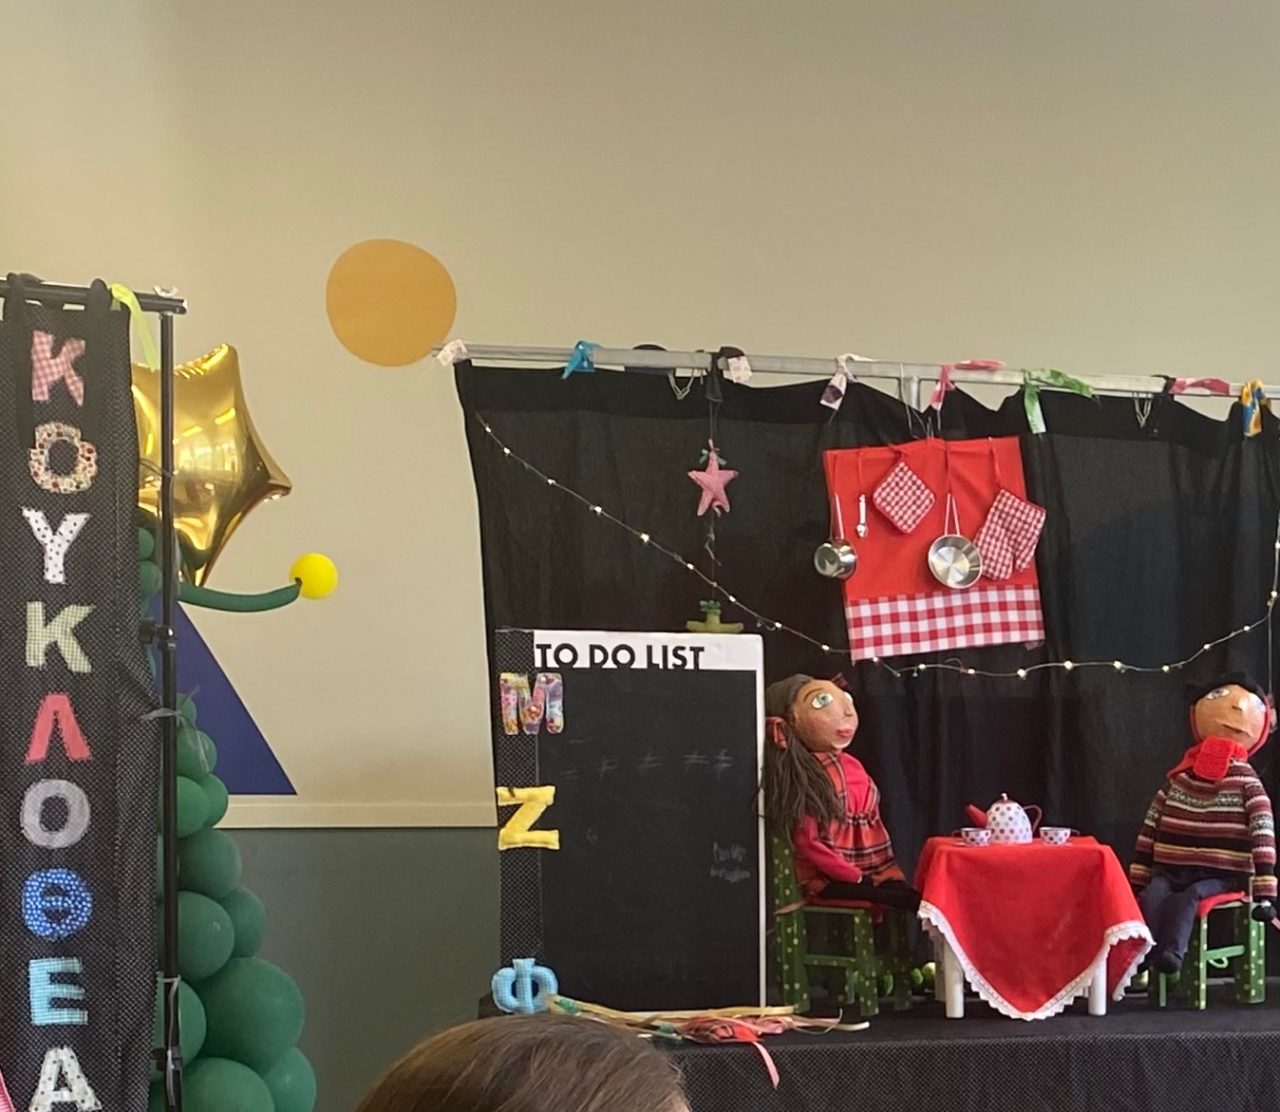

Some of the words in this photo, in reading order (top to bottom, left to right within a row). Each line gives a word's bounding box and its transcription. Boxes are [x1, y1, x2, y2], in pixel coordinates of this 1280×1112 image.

[535, 642, 579, 669] TO
[588, 643, 636, 670] DO
[646, 645, 705, 670] LIST
